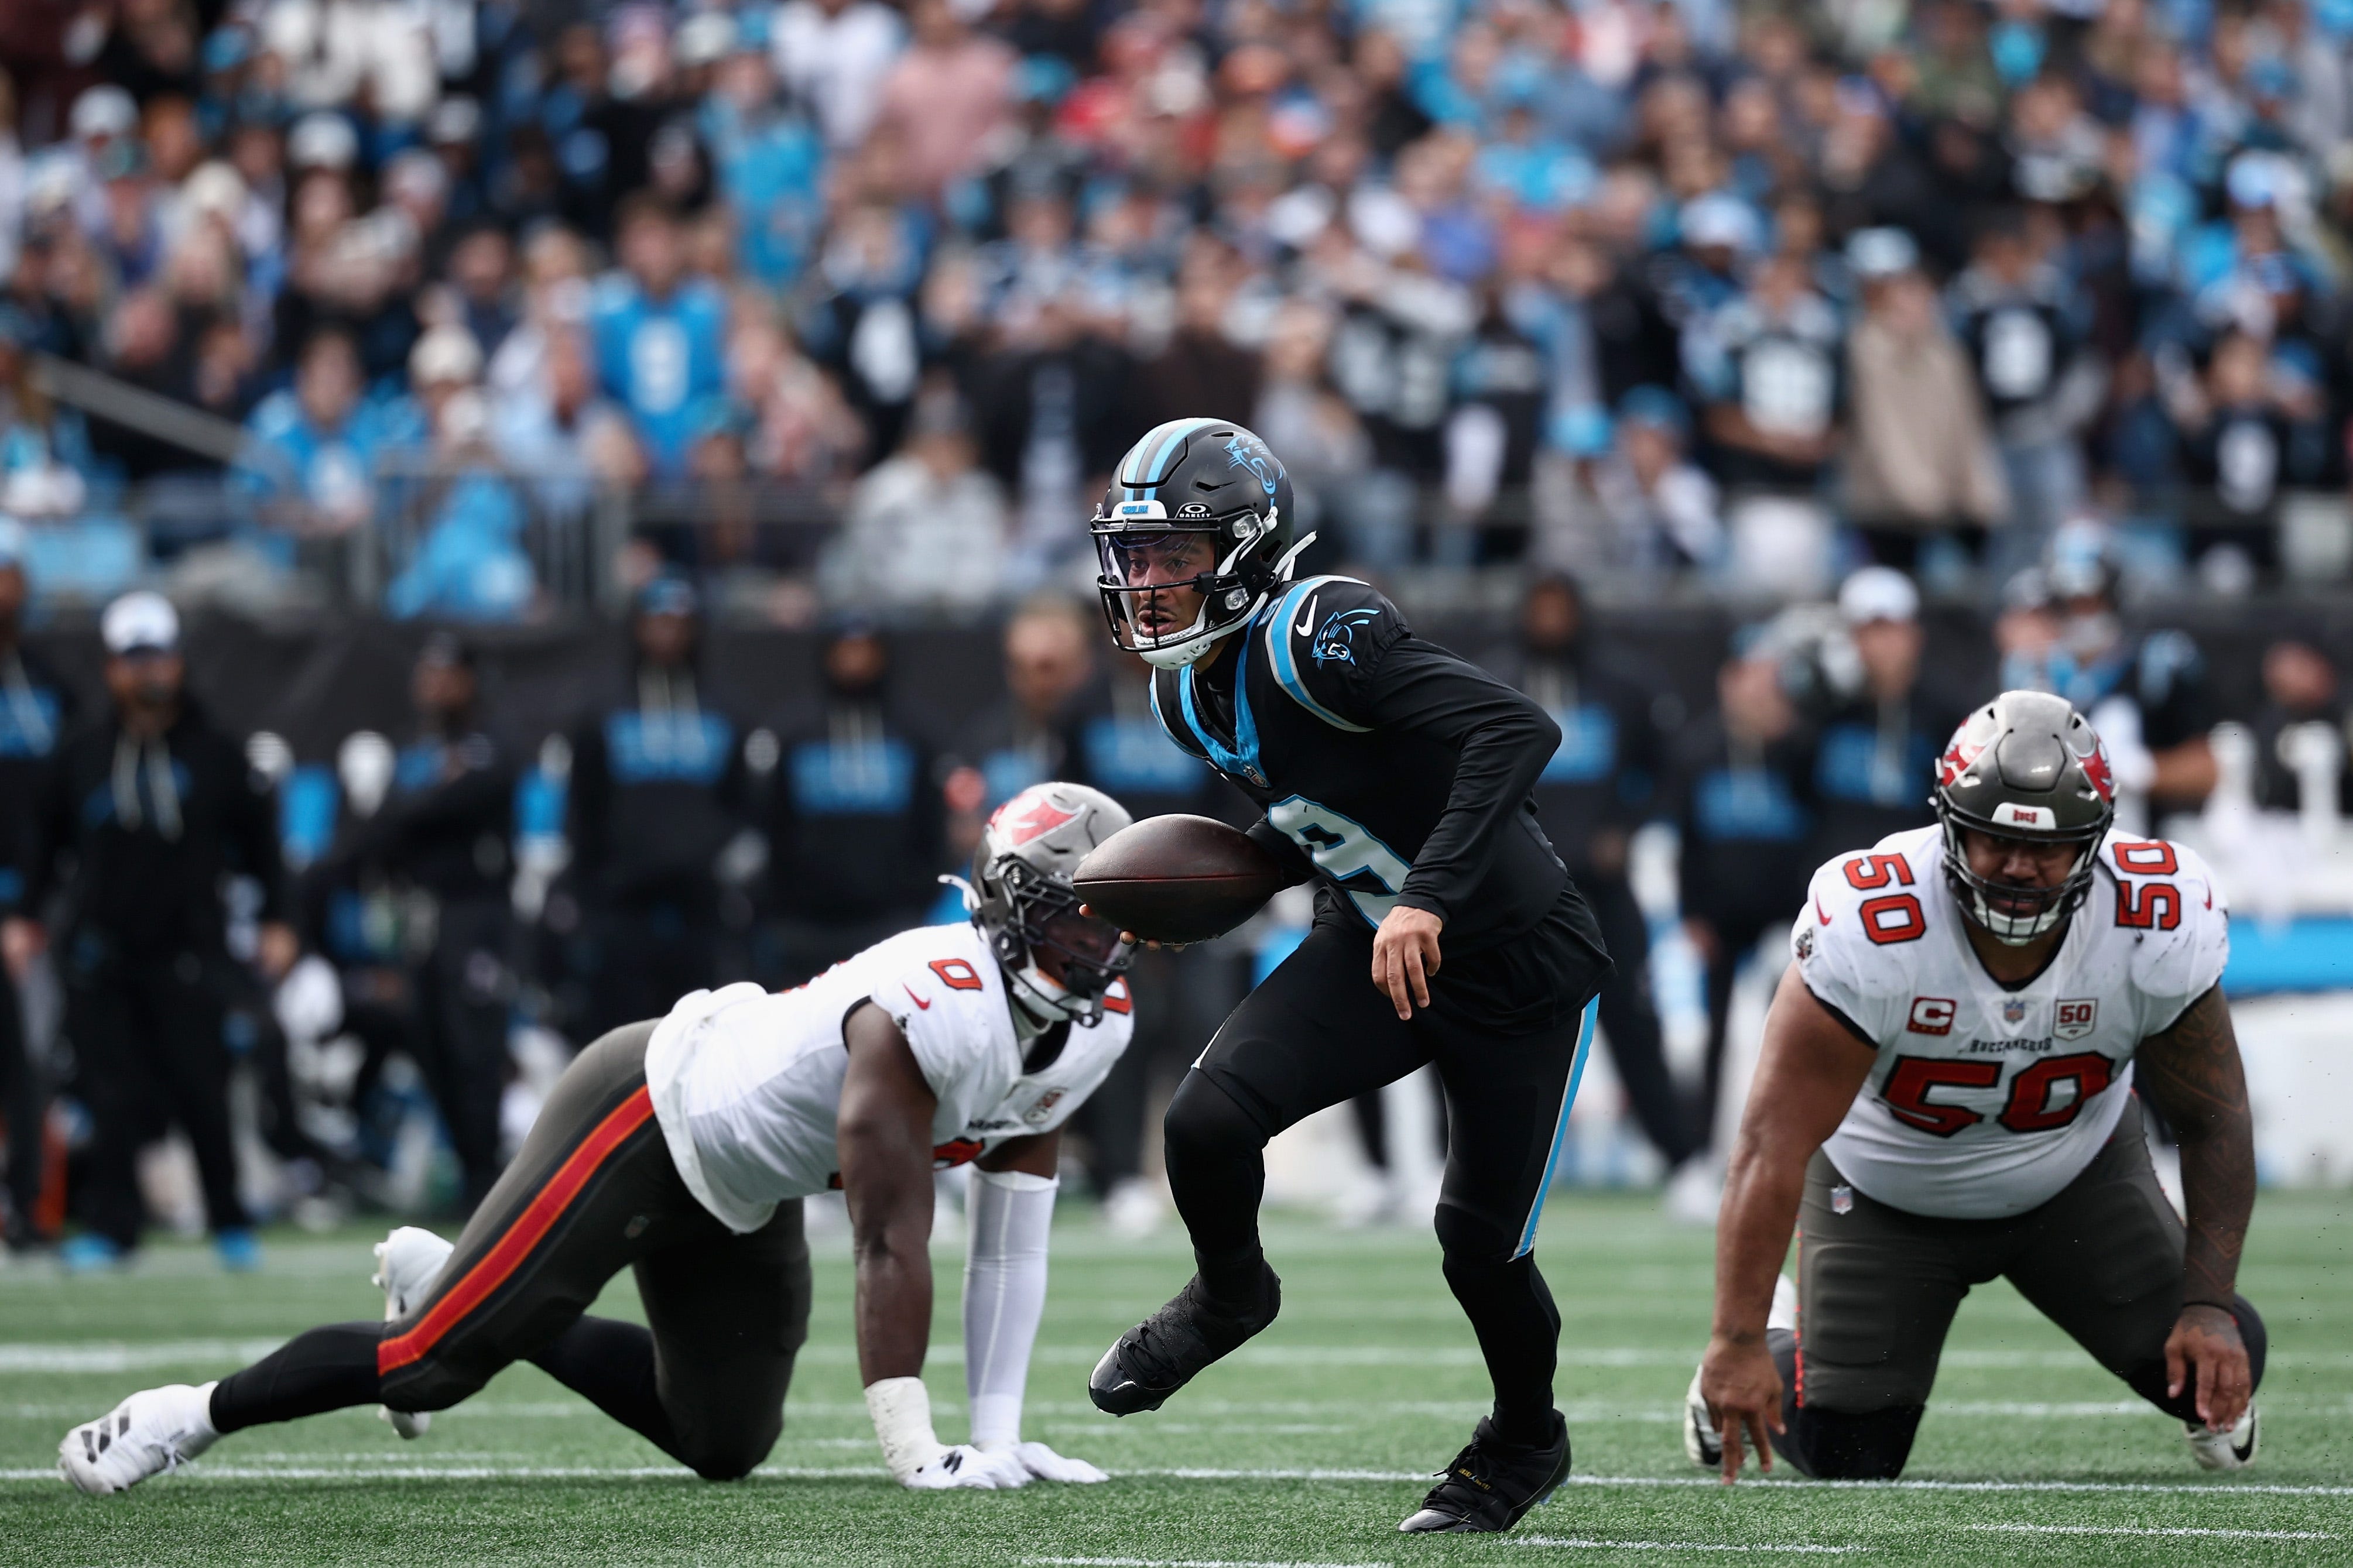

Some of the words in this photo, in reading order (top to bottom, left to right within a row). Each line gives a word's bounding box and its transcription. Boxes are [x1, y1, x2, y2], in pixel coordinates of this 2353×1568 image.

[1268, 794, 1413, 931] 9
[1842, 852, 1926, 946] 50
[2112, 840, 2181, 932] 50
[928, 958, 982, 991] 0
[1913, 1000, 1953, 1027] C
[2060, 1004, 2091, 1023] 50
[1880, 1051, 2115, 1138] 50
